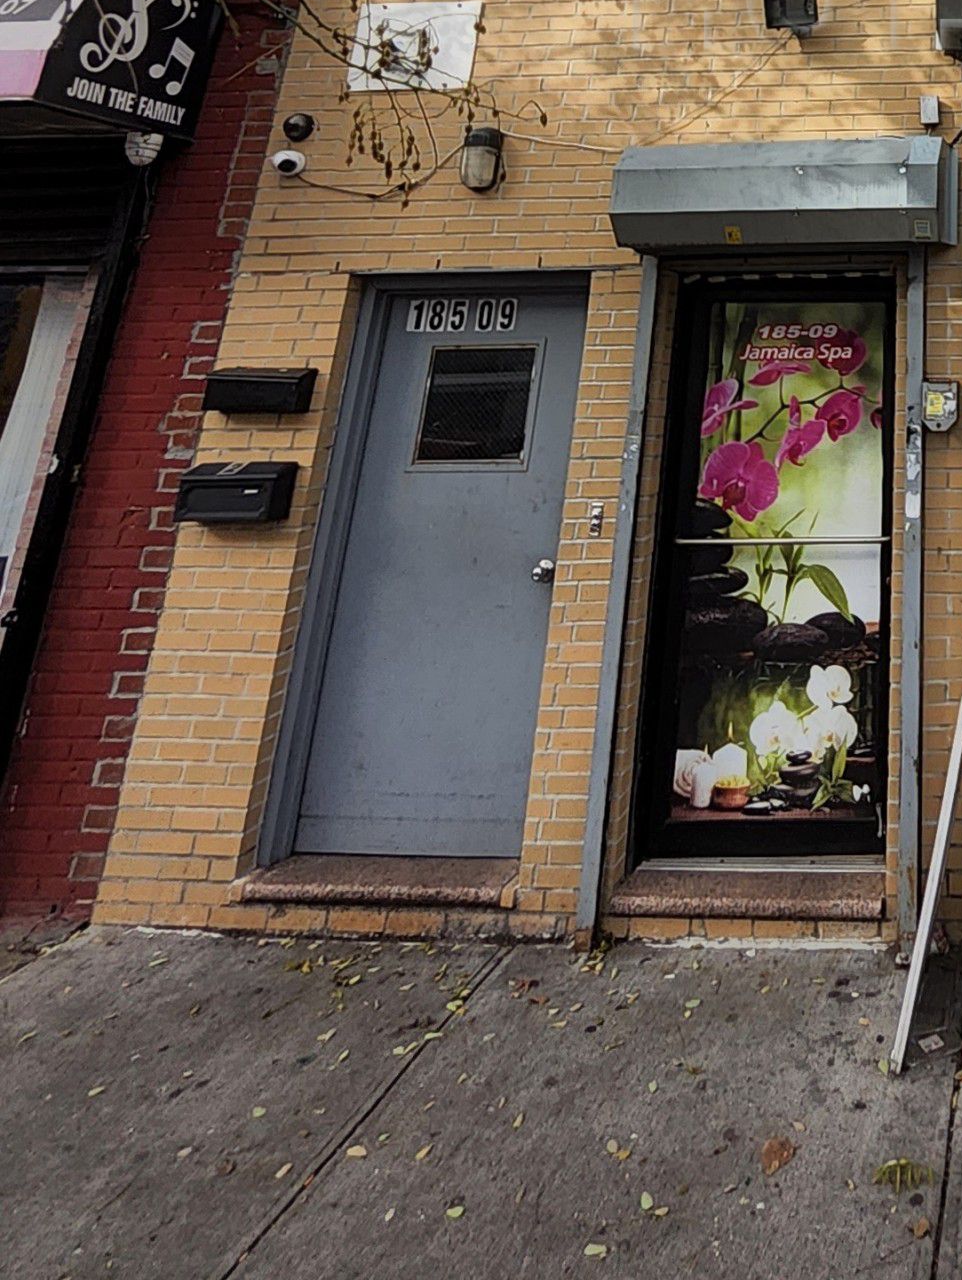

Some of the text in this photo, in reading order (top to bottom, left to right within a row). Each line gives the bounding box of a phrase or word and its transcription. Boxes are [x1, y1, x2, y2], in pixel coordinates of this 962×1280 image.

[67, 77, 186, 126] JOIN THE FAMILY
[412, 299, 516, 331] 185 09
[758, 324, 838, 340] 185-09
[740, 342, 853, 363] Jamaica Spa
